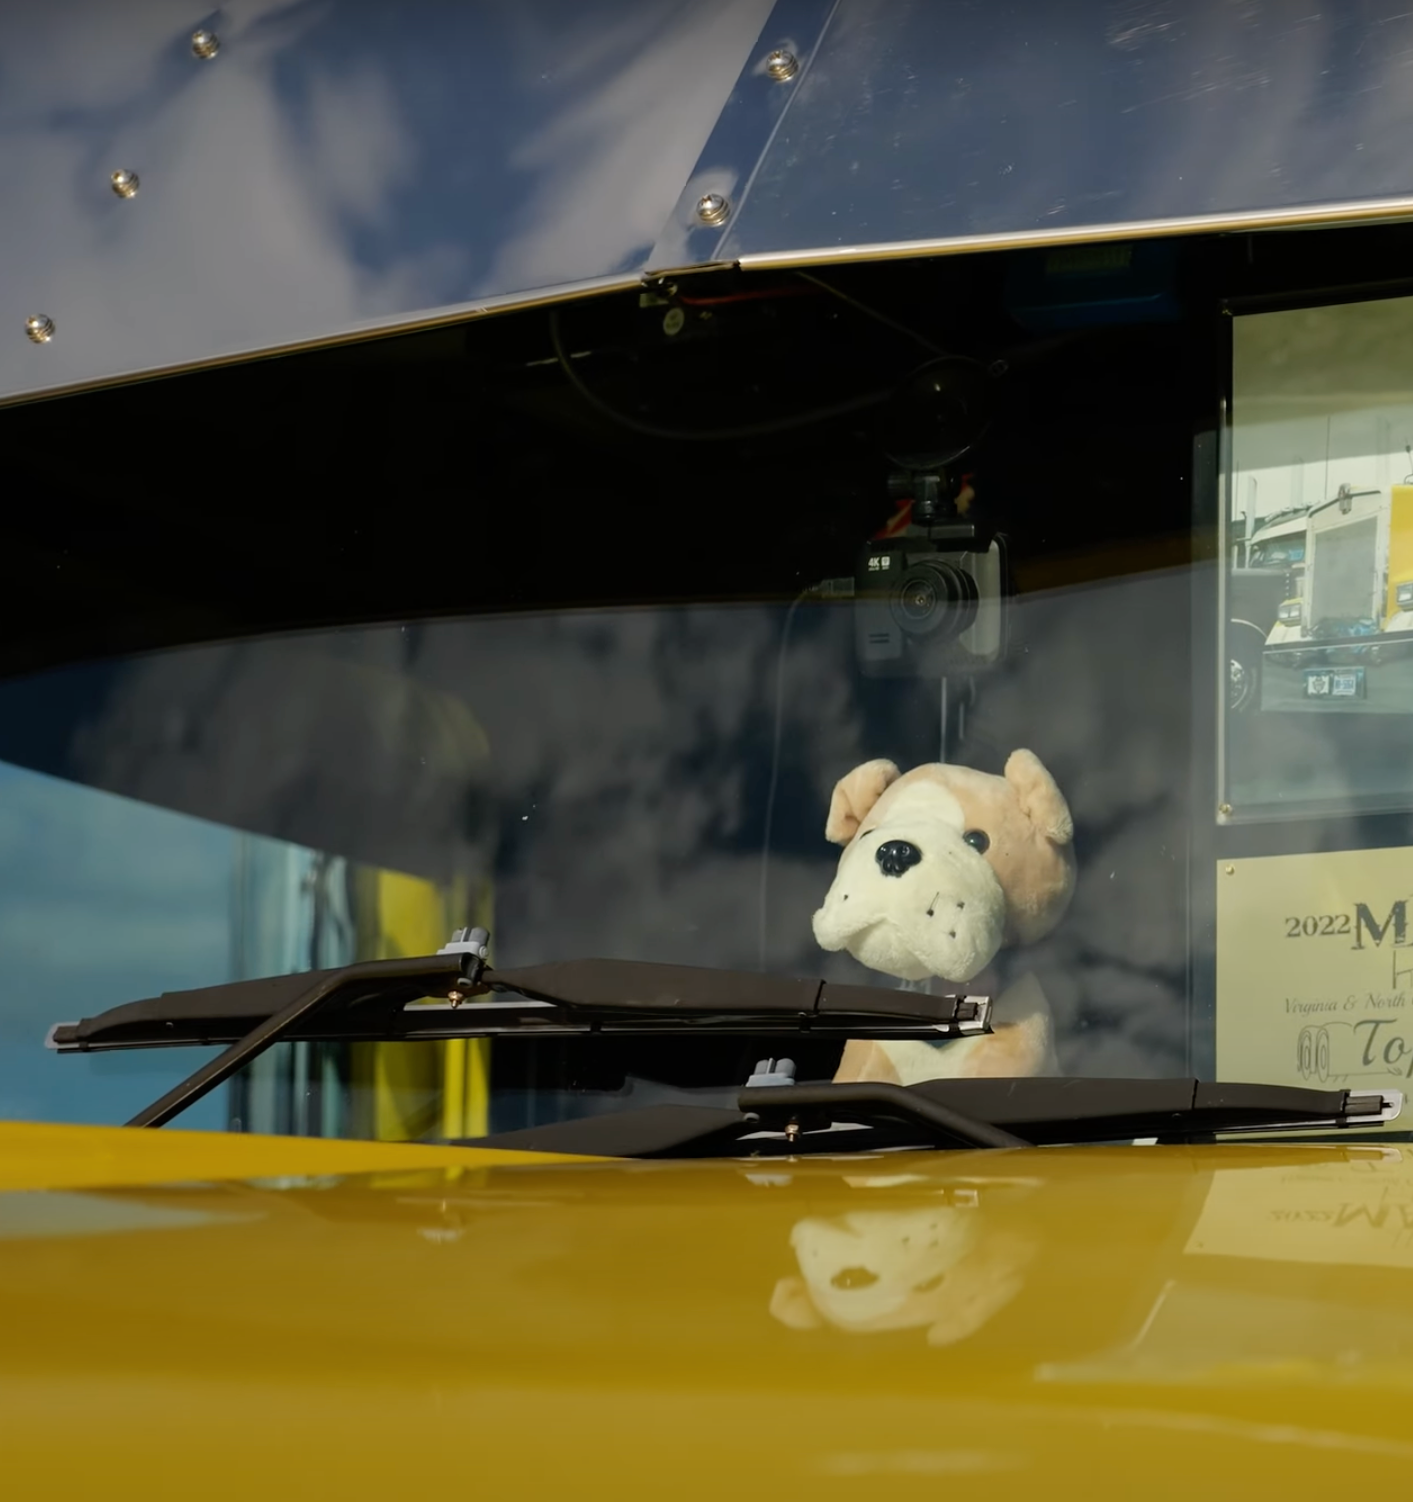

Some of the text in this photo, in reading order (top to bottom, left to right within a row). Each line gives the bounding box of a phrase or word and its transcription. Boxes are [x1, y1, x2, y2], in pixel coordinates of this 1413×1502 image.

[868, 556, 880, 566] 4K
[1285, 914, 1350, 938] 2022
[1285, 997, 1337, 1017] Virginia
[1343, 995, 1358, 1011] &
[1365, 993, 1405, 1010] North
